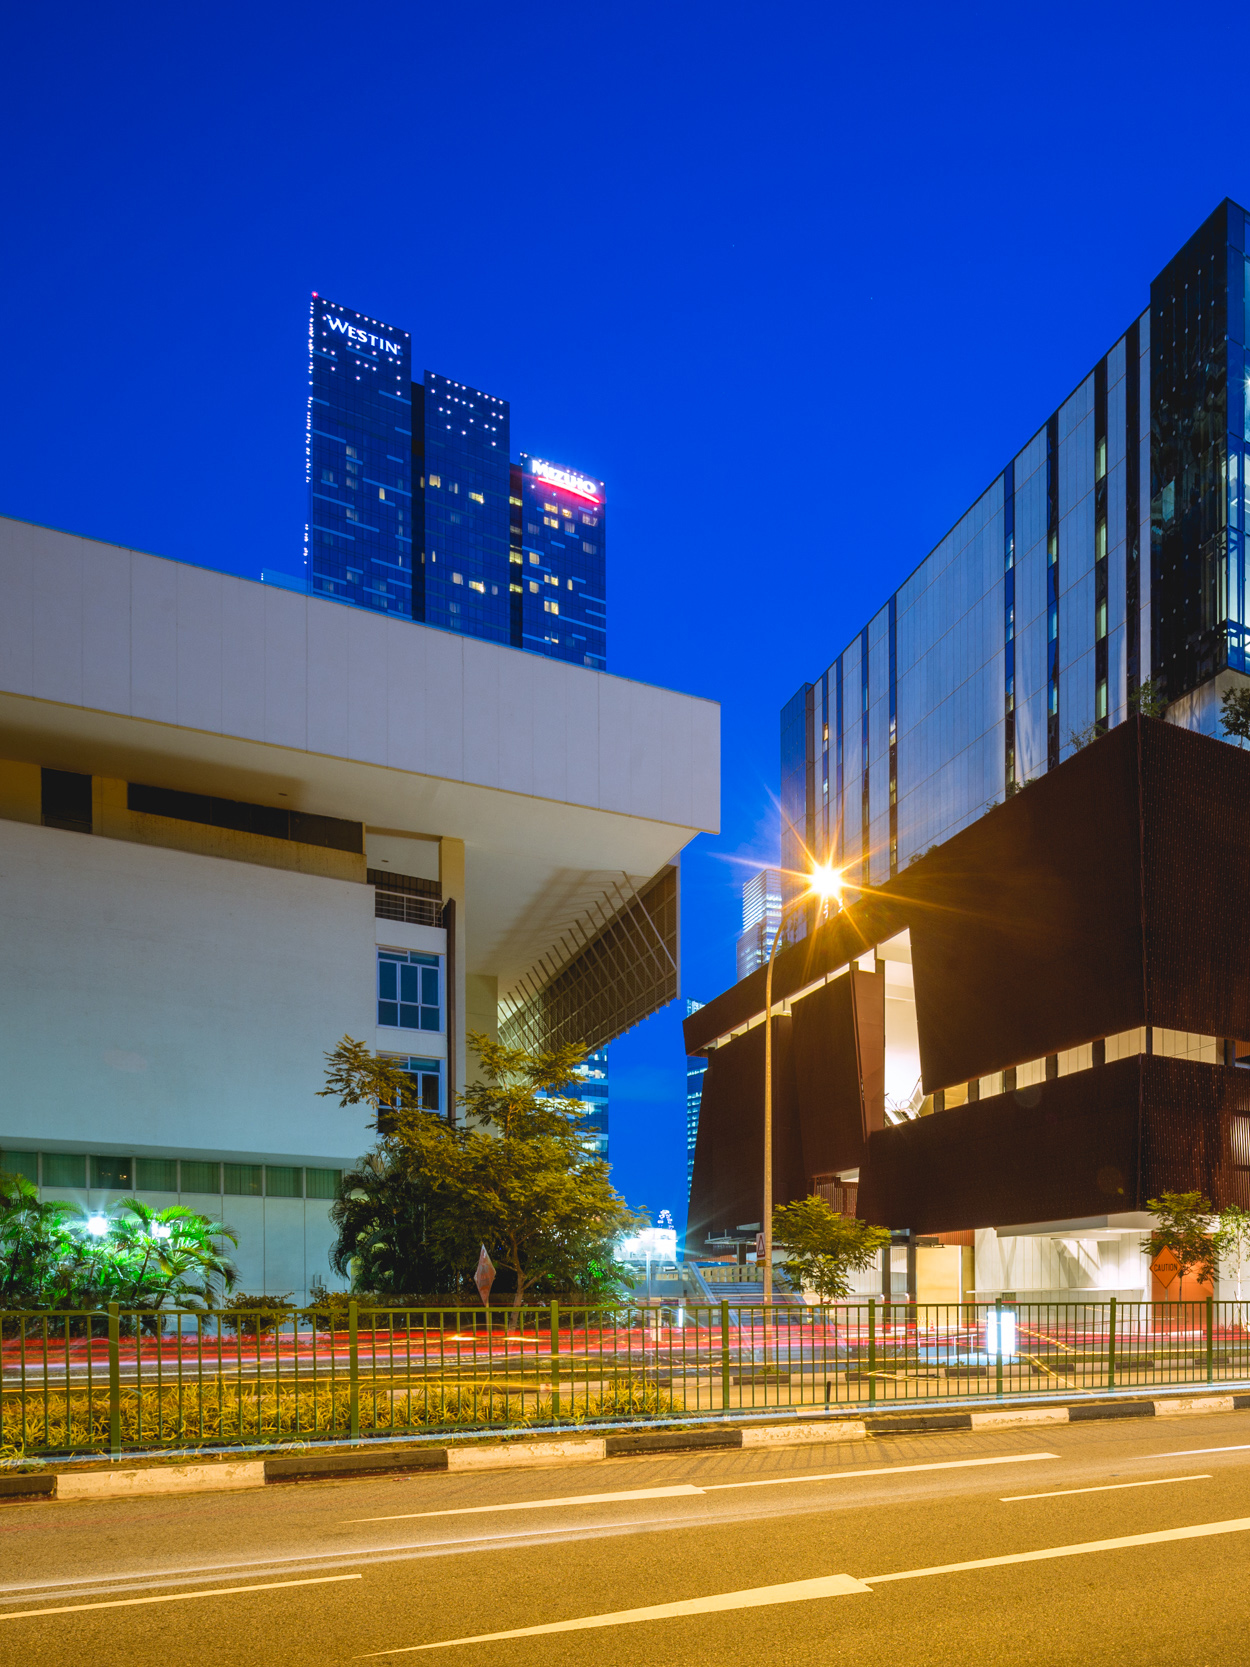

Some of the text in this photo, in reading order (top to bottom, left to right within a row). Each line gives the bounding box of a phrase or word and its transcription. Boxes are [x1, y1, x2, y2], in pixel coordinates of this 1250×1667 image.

[326, 314, 398, 355] WESTIN
[531, 460, 597, 493] MIZUHO
[1154, 1263, 1178, 1272] CAUTION
